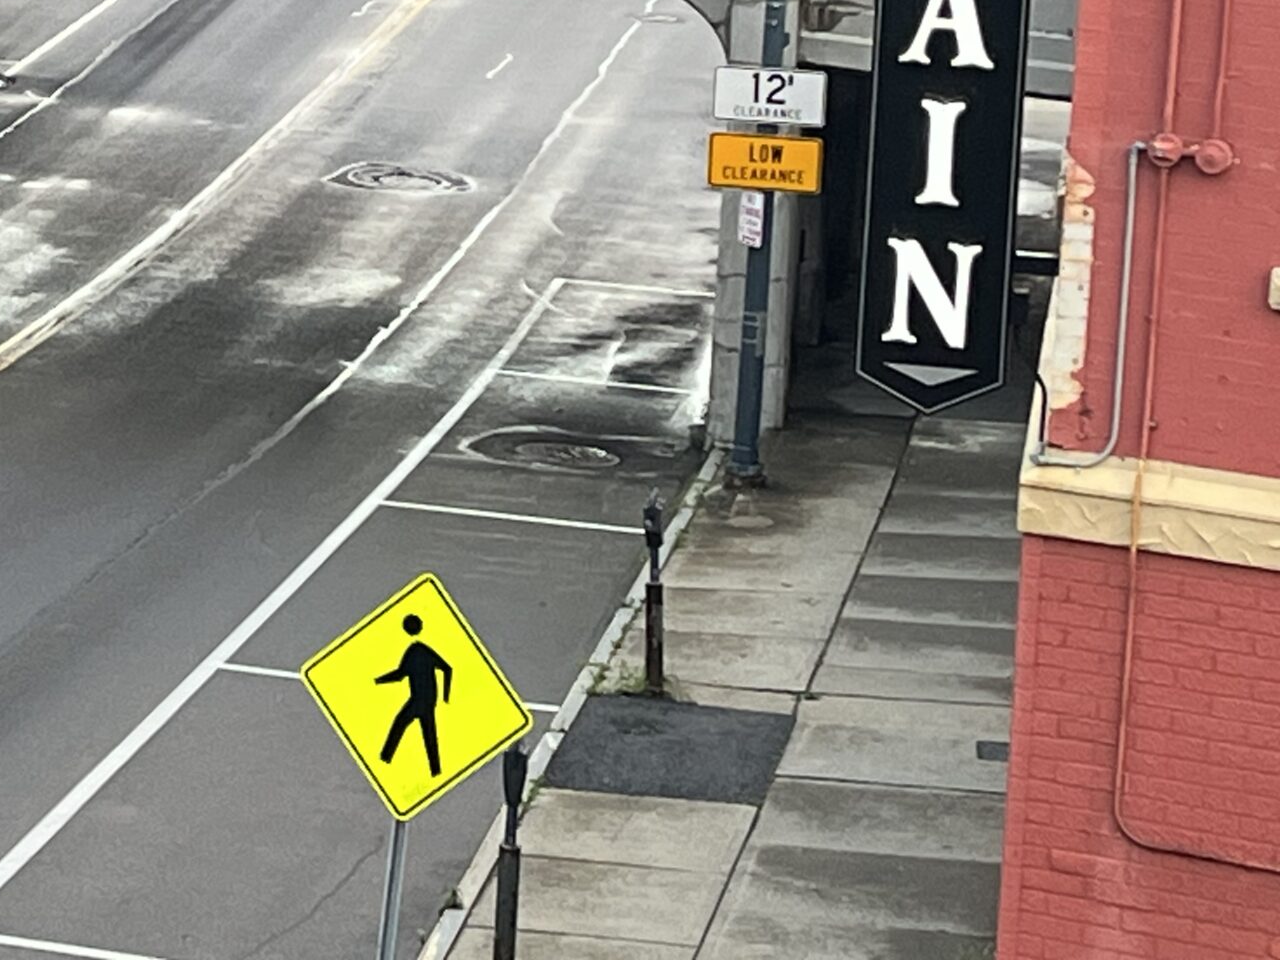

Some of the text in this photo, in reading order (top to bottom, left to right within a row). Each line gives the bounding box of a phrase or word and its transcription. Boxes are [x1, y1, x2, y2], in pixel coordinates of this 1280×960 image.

[733, 105, 802, 121] CLEARANCE
[749, 143, 785, 164] LOW
[723, 166, 805, 186] CLEARANCE
